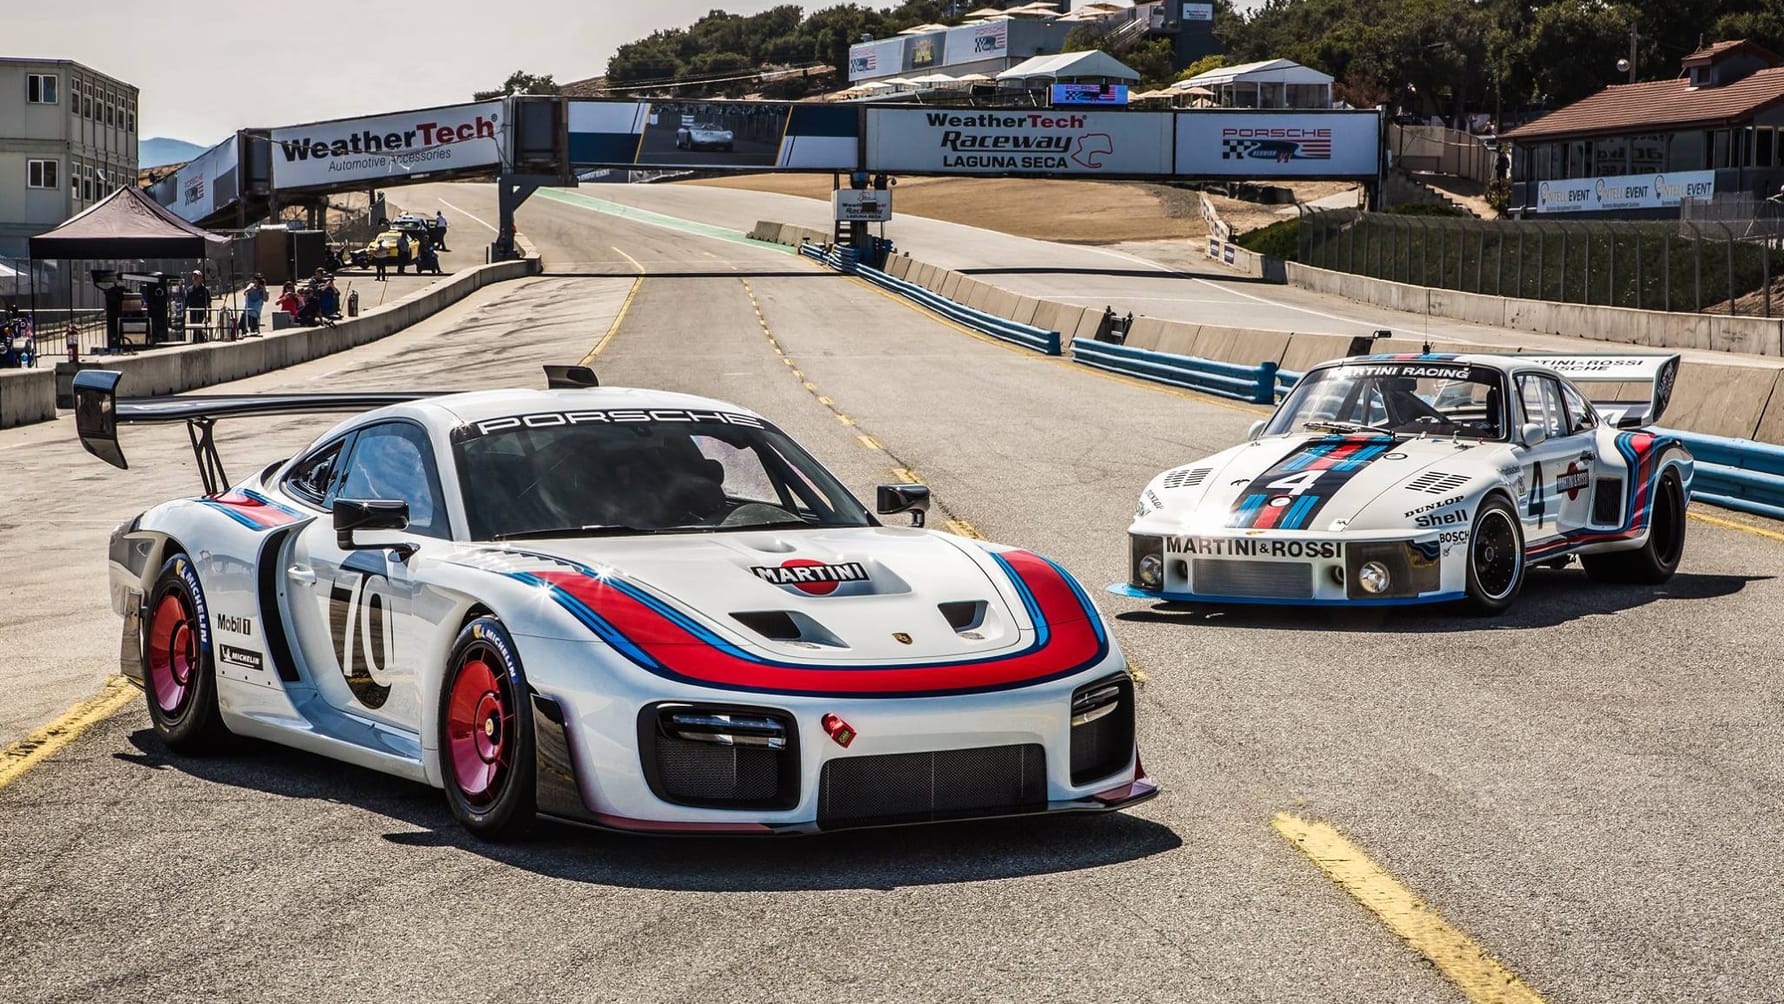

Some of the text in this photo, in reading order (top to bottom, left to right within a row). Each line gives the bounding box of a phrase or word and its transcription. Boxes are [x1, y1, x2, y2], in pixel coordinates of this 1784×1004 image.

[926, 113, 1085, 128] WeatherTech
[940, 131, 1073, 152] Raceway
[1222, 128, 1332, 138] PORSCHE
[328, 147, 452, 172] Automotive Accessories
[943, 156, 1068, 169] LAGUNA SECA
[1402, 366, 1470, 379] RACING
[476, 410, 765, 435] PORSCHE
[1265, 469, 1328, 496] 4
[1528, 460, 1546, 530] 4
[1404, 495, 1464, 518] DUNLOP
[1415, 509, 1468, 527] Shell
[1439, 530, 1470, 544] BOSCH
[756, 563, 866, 584] MARTINI
[186, 572, 208, 643] MICHELIN
[217, 613, 242, 634] Mobil
[333, 568, 394, 688] 70
[231, 650, 260, 665] MICHELIN
[486, 629, 516, 678] MICHELIN
